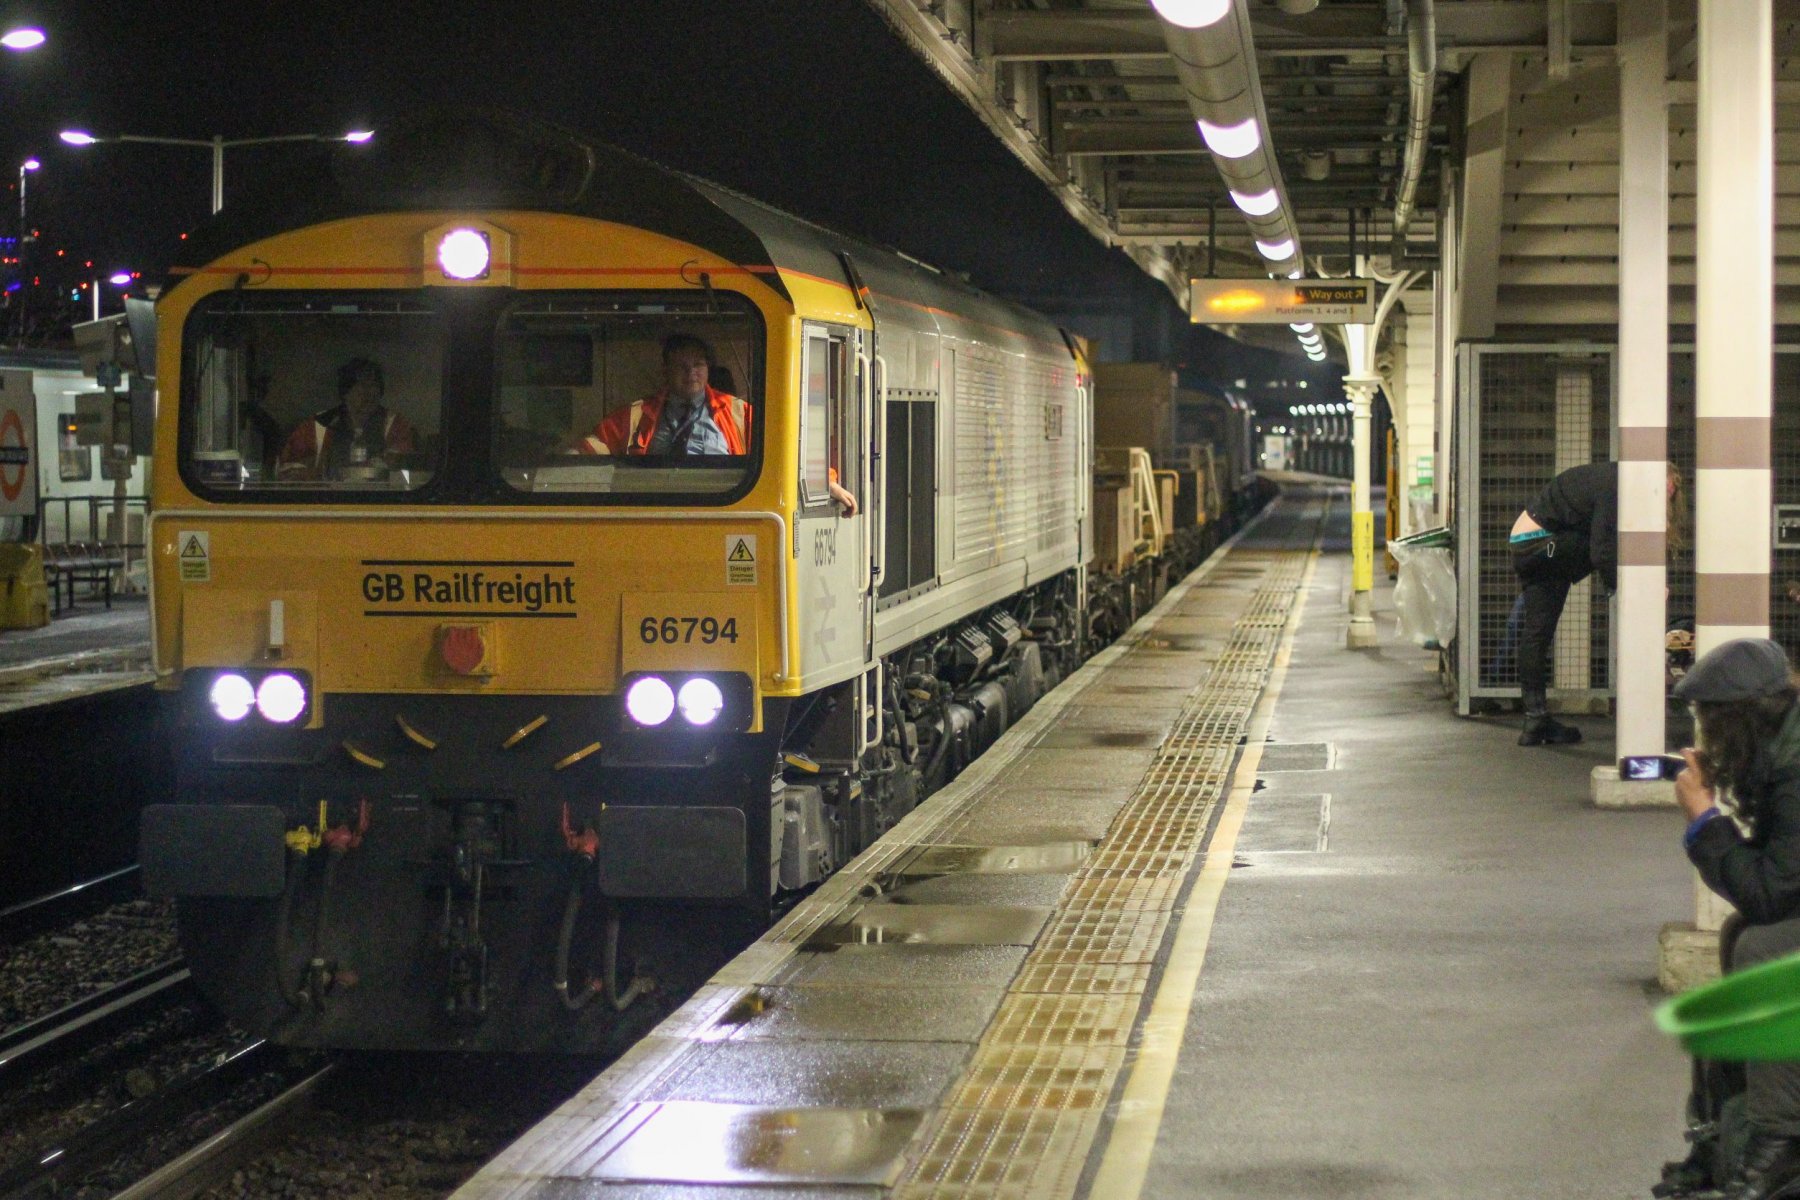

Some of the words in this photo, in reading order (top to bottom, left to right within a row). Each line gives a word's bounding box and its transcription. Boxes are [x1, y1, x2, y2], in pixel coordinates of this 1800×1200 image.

[1309, 289, 1332, 300] Way
[1335, 290, 1353, 299] out
[1276, 307, 1314, 315] Platforms
[1333, 307, 1348, 315] and
[814, 528, 837, 567] 66794
[362, 573, 405, 602] GB
[413, 572, 576, 612] Railfreight
[640, 616, 739, 644] 66794
